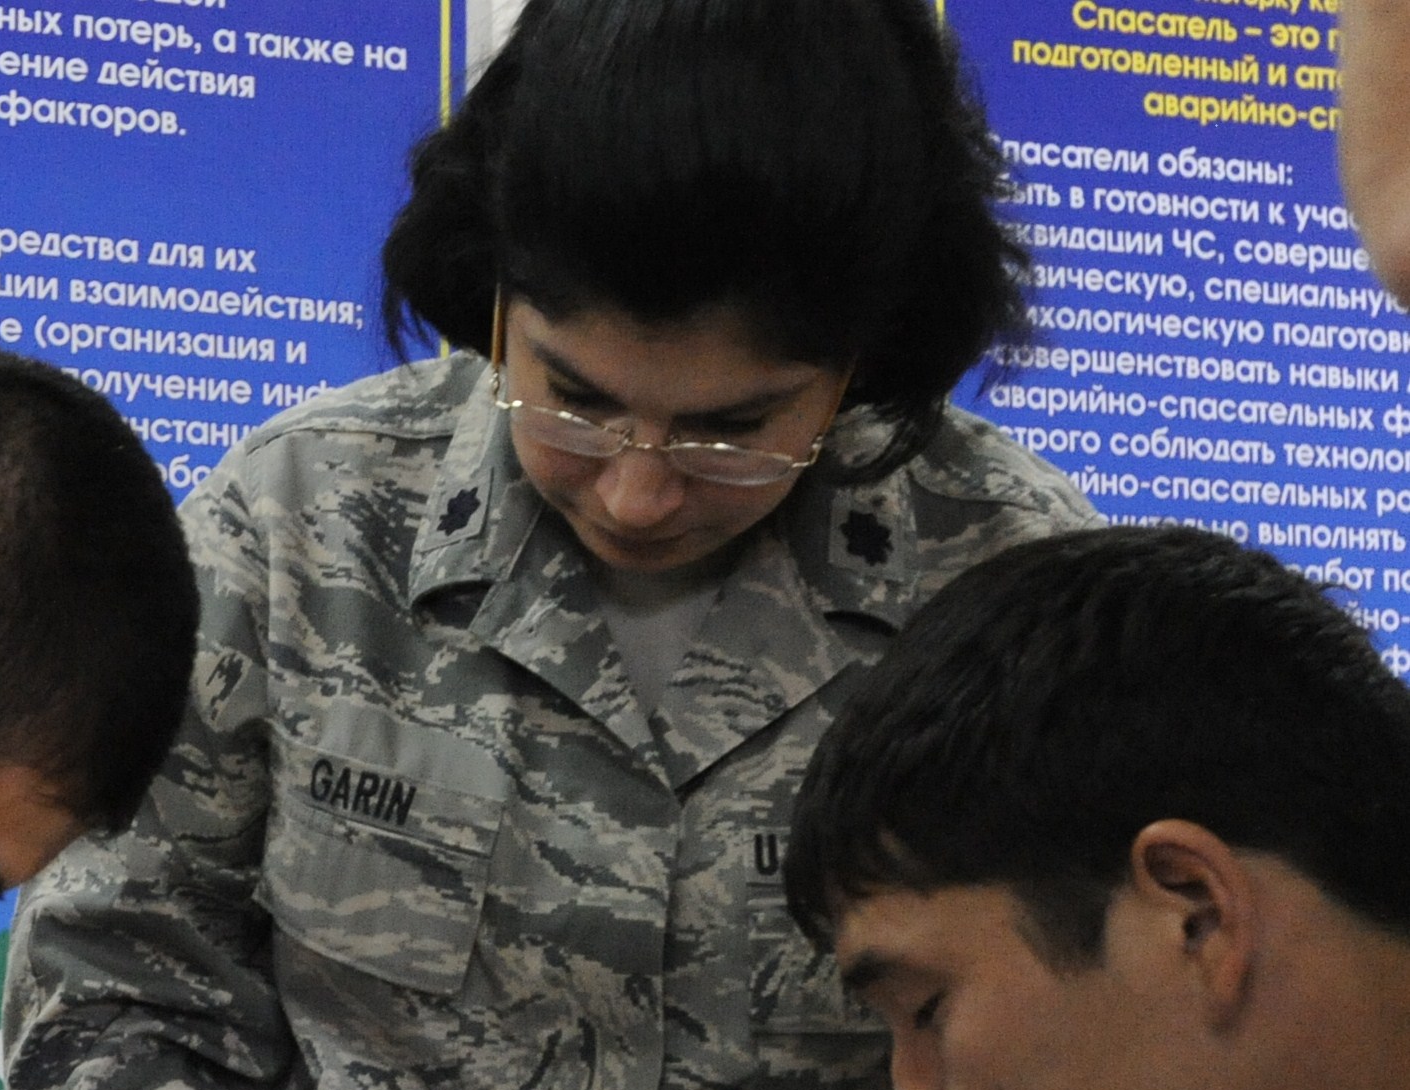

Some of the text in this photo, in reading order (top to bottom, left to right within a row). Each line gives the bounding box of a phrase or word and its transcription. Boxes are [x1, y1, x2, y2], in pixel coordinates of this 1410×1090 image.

[73, 14, 202, 54] потерь,
[212, 28, 236, 54] а
[244, 31, 355, 65] также
[364, 44, 407, 71] на
[1072, 0, 1238, 43] Спасатель
[1269, 23, 1321, 51] это
[97, 58, 255, 99] действия
[1012, 40, 1259, 84] подготовленный
[1267, 63, 1287, 87] и
[985, 132, 1293, 186] пасатели обязаны:
[1069, 186, 1085, 209] в
[1093, 187, 1260, 223] готовности
[1268, 201, 1286, 225] к
[147, 241, 205, 269] для
[215, 247, 256, 273] их
[1172, 228, 1225, 264] ЧС,
[69, 279, 363, 330] взаимодействия;
[34, 315, 275, 362] (организация
[286, 340, 307, 365] и
[1289, 363, 1399, 392] навыки
[989, 384, 1375, 431] аварийно-спасательных
[1109, 426, 1276, 465] соблюдать
[1258, 522, 1407, 552] выполнять
[1284, 557, 1375, 590] абот
[309, 758, 417, 826] GARIN
